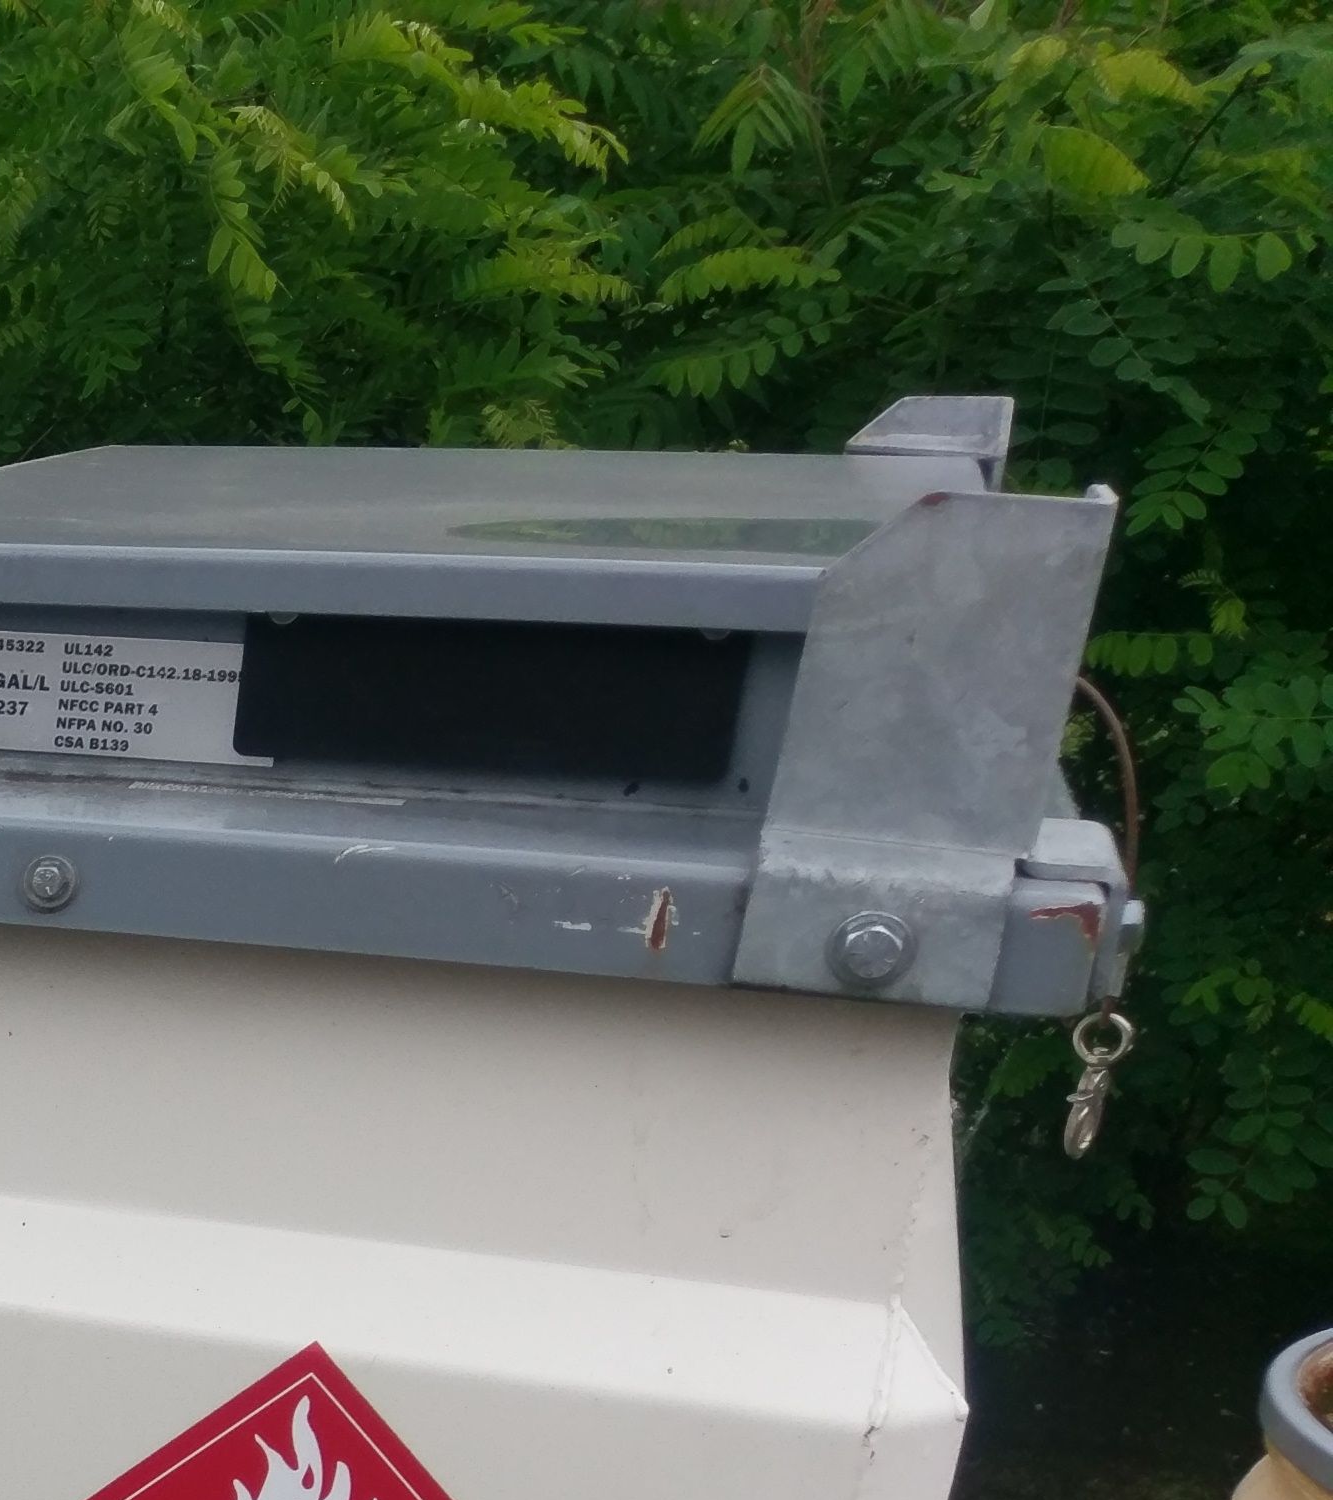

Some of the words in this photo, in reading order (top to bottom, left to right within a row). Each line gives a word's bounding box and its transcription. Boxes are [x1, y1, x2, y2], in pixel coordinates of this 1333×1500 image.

[64, 642, 114, 657] UL142
[60, 679, 134, 697] ULC-S601
[58, 698, 99, 713] NFCC
[104, 701, 145, 716] PART
[148, 704, 159, 716] 4
[56, 717, 96, 731] NFPA
[101, 720, 129, 733] NO.
[133, 722, 153, 735] 30
[54, 735, 84, 749] CSA
